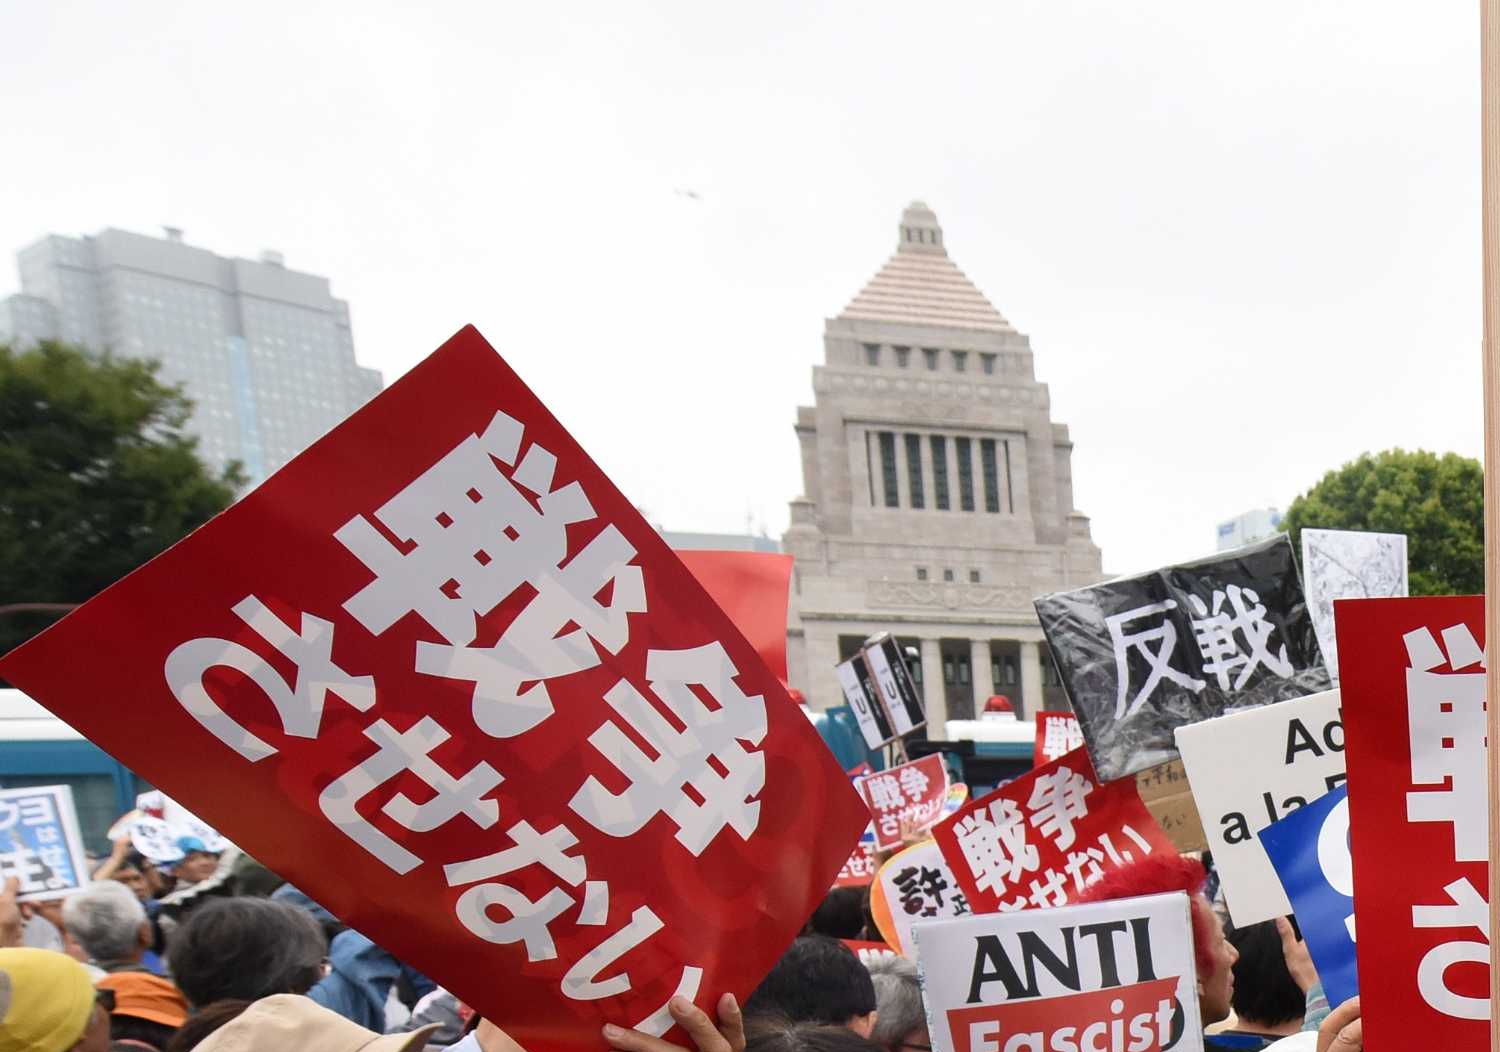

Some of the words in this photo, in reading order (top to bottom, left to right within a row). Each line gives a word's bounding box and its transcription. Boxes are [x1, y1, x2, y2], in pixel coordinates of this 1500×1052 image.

[332, 409, 768, 858] 戦争
[1104, 583, 1295, 720] 反戦
[163, 593, 703, 1038] させない
[866, 765, 930, 812] 戦争
[952, 765, 1094, 898] 戦争
[892, 865, 948, 918] 許
[965, 916, 1158, 1005] ANTI
